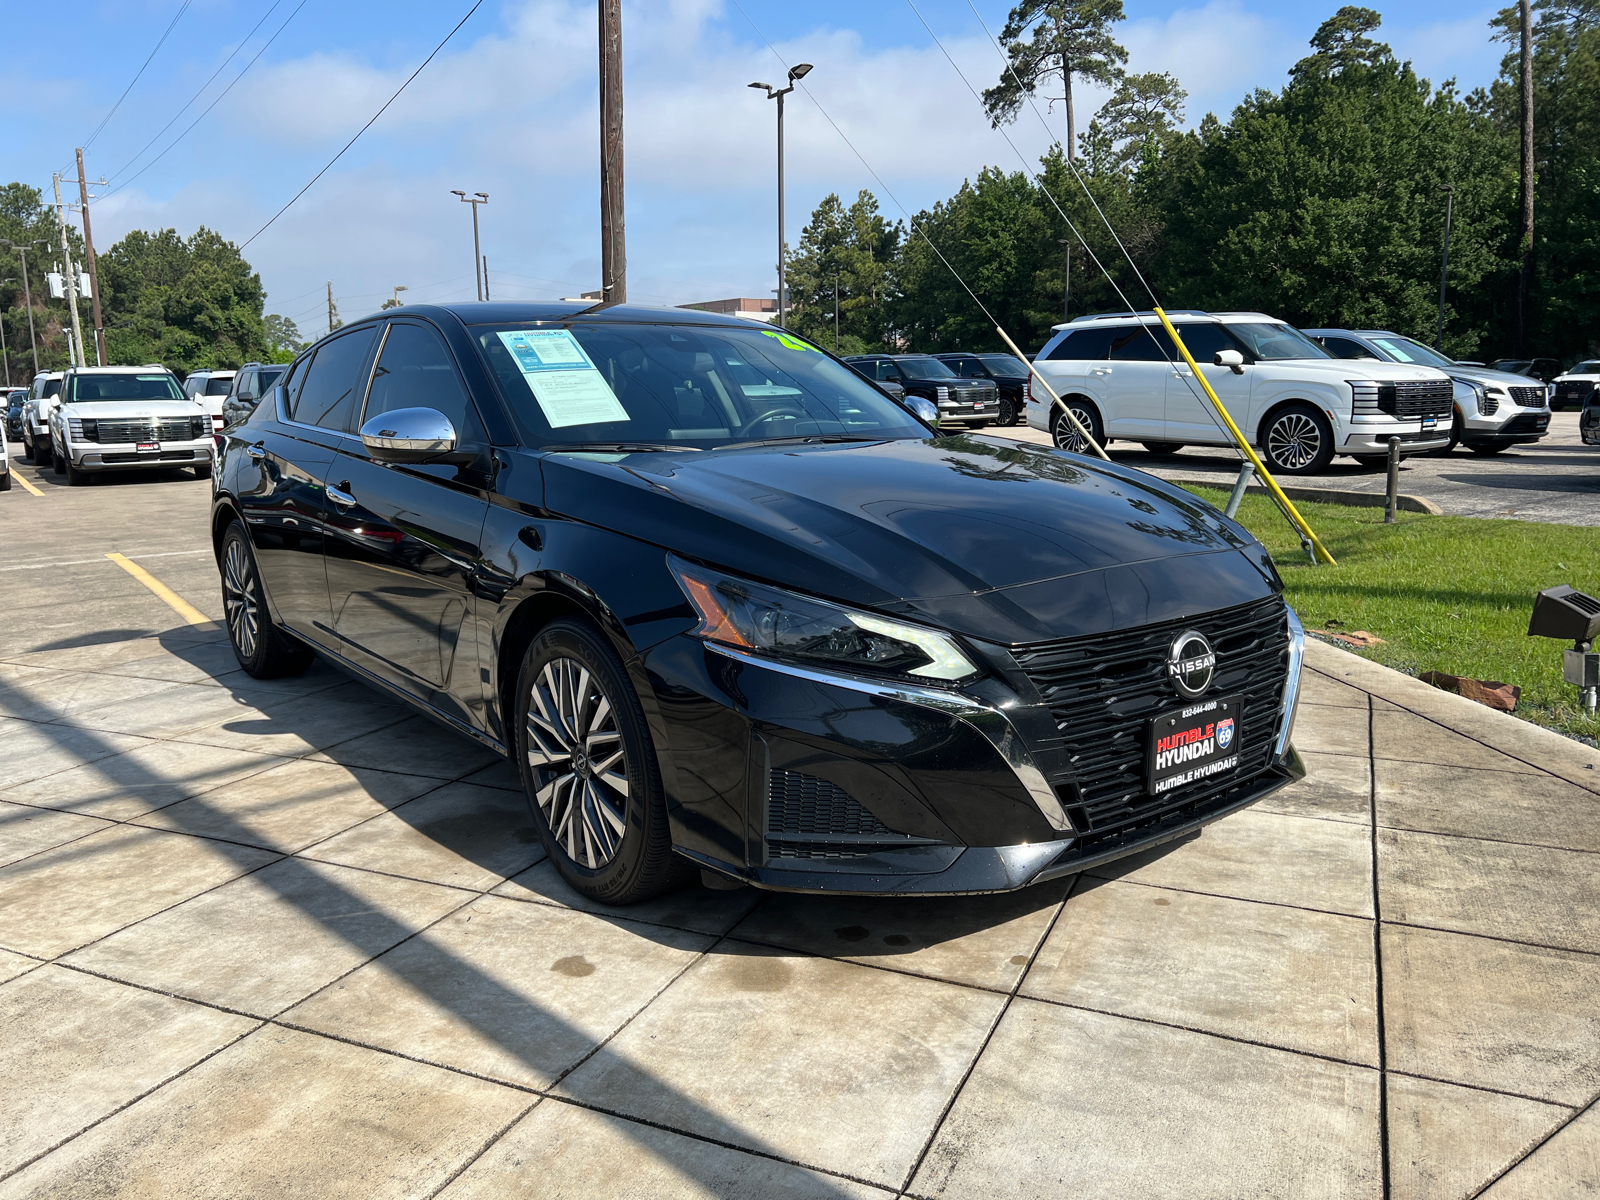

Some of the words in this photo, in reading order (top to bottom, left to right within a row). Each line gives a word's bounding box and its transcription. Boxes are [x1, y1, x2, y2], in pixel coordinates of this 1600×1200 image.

[577, 643, 616, 697] SOLUS
[1170, 653, 1216, 676] NISSAN
[1182, 701, 1217, 718] 832-644-4000
[1157, 723, 1215, 753] HUMBLE
[1219, 729, 1231, 744] 69
[1156, 738, 1215, 770] HYUNDAI
[1155, 771, 1193, 794] HUMBLE
[1194, 758, 1232, 779] HYUNDAI
